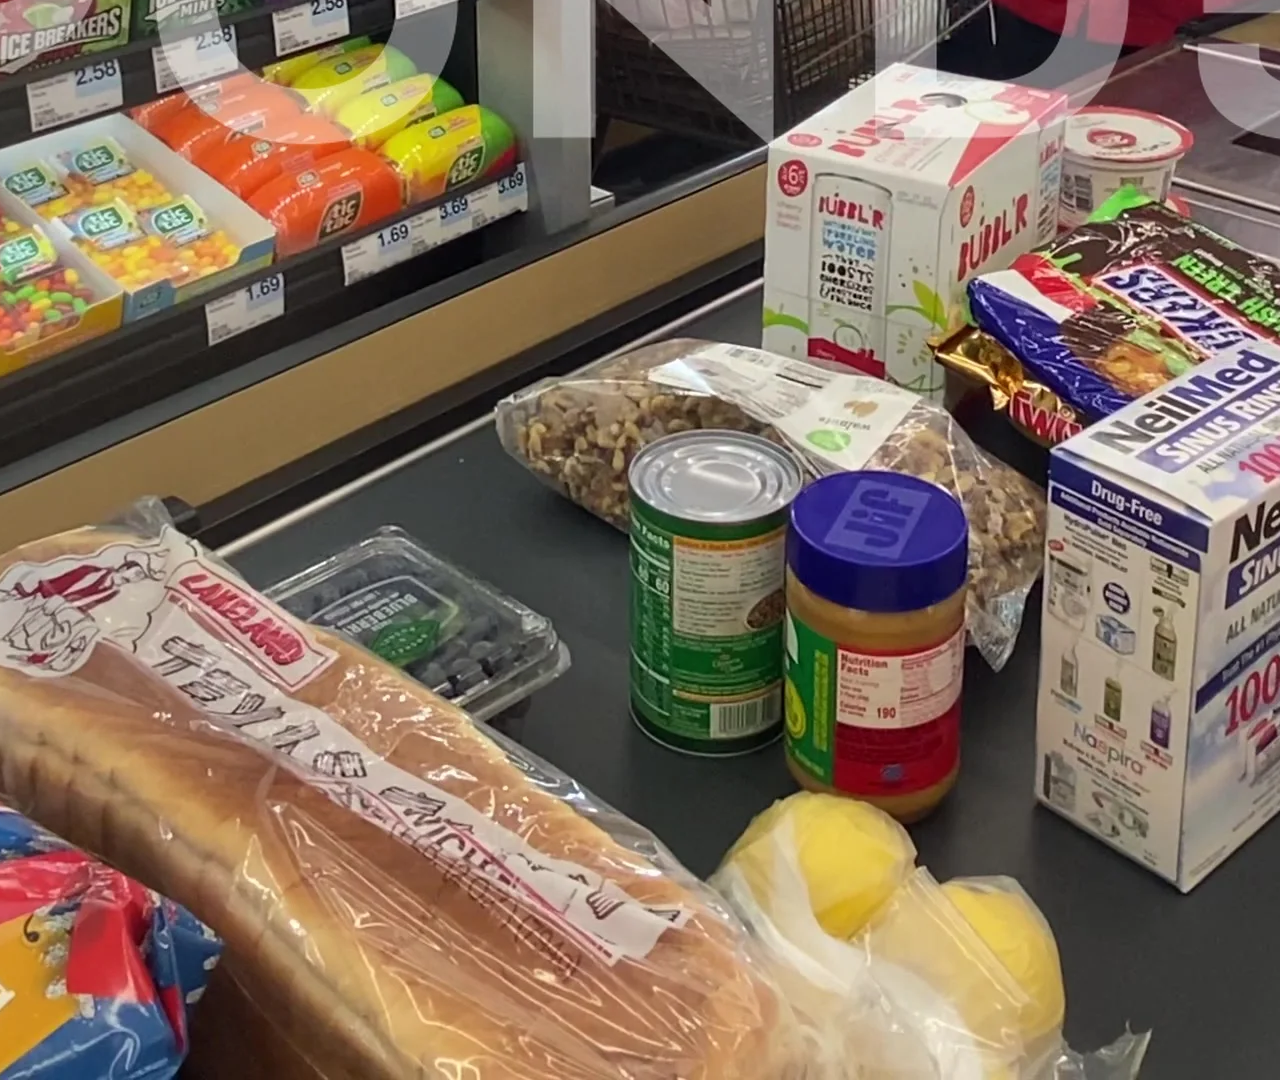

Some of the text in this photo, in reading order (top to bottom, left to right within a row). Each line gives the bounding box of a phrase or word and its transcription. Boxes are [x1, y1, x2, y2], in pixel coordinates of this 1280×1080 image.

[0, 8, 122, 57] ICE BREAKERS
[195, 26, 233, 50] 2.58
[75, 60, 117, 85] 2.58
[497, 171, 524, 195] 3.69
[439, 197, 468, 221] 3.69
[377, 223, 408, 249] 1.69
[245, 277, 281, 301] 1.69
[1089, 350, 1280, 455] NeilMed
[1156, 416, 1241, 464] SINUS
[1091, 480, 1162, 526] Drug-Free
[179, 573, 305, 665] LAKELAND
[1226, 616, 1246, 644] ALL
[840, 653, 888, 670] Nutrition
[840, 664, 869, 677] Facts
[877, 706, 897, 720] 190
